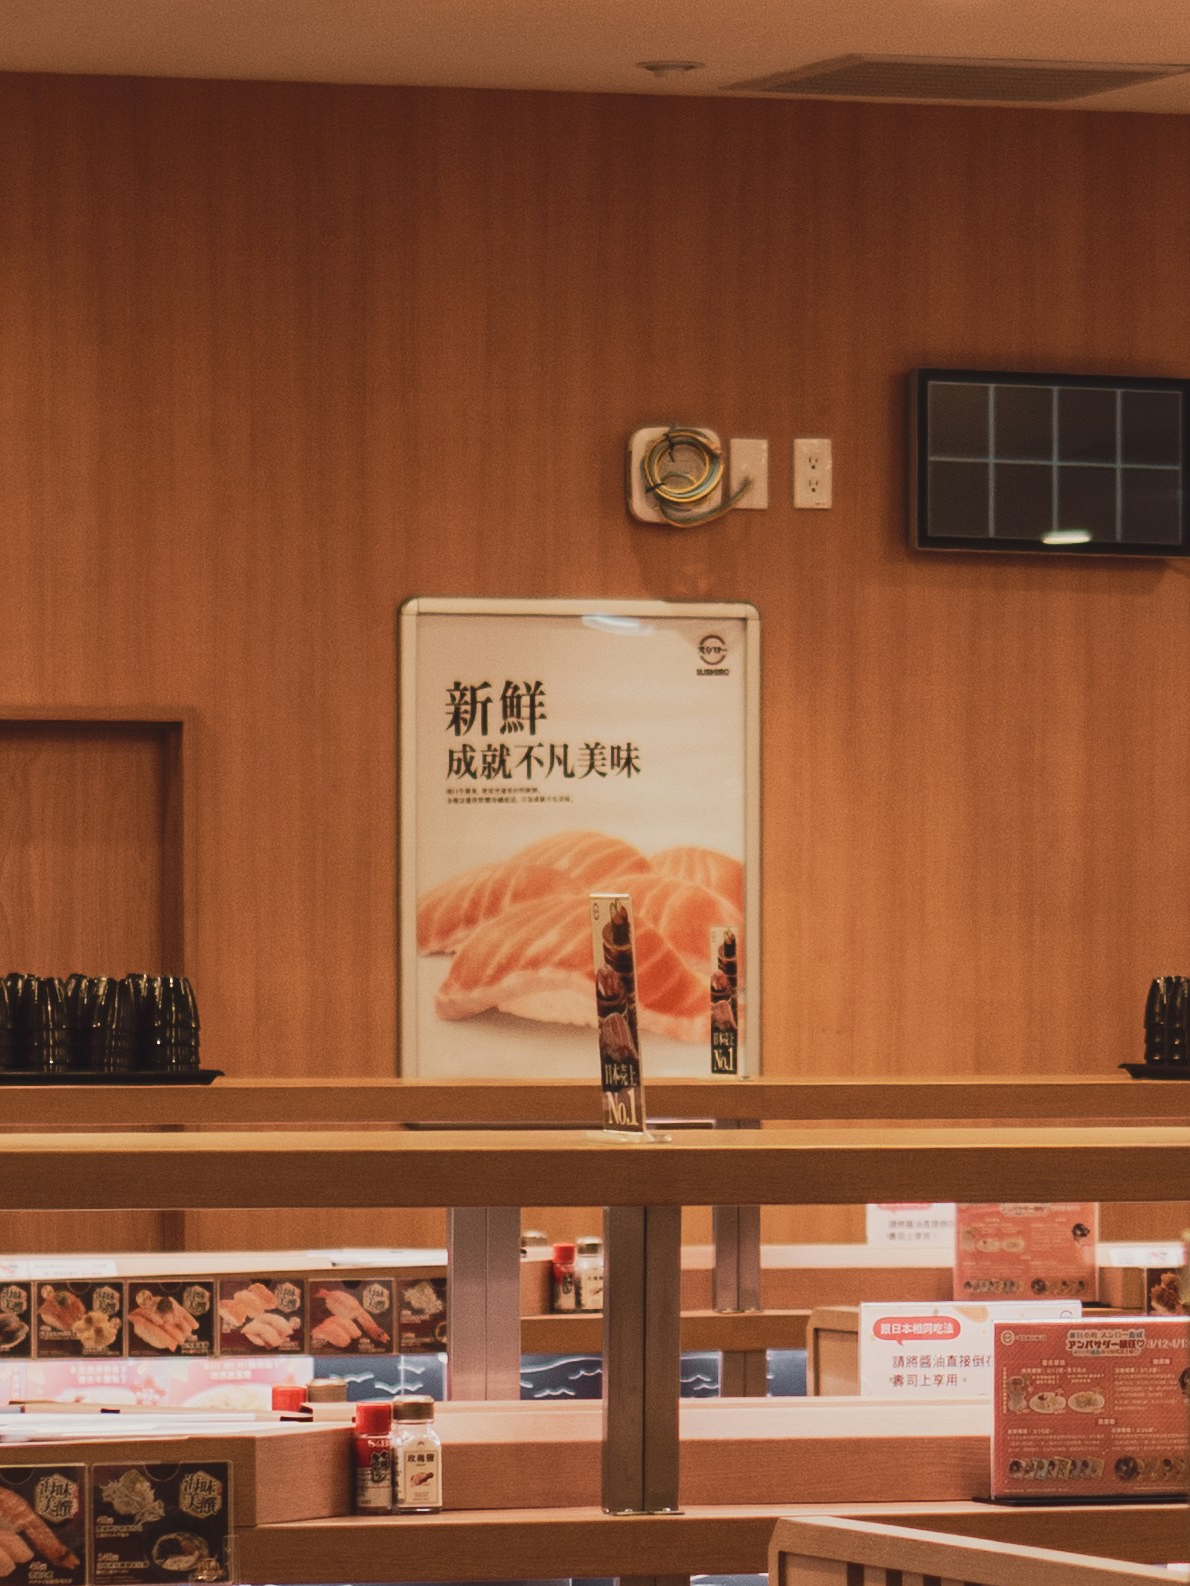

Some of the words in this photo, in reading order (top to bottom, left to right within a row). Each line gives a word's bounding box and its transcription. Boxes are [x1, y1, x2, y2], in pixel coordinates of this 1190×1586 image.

[444, 680, 547, 737] 新鮮
[446, 742, 641, 781] 成就不凡美味
[606, 1089, 639, 1126] No.1
